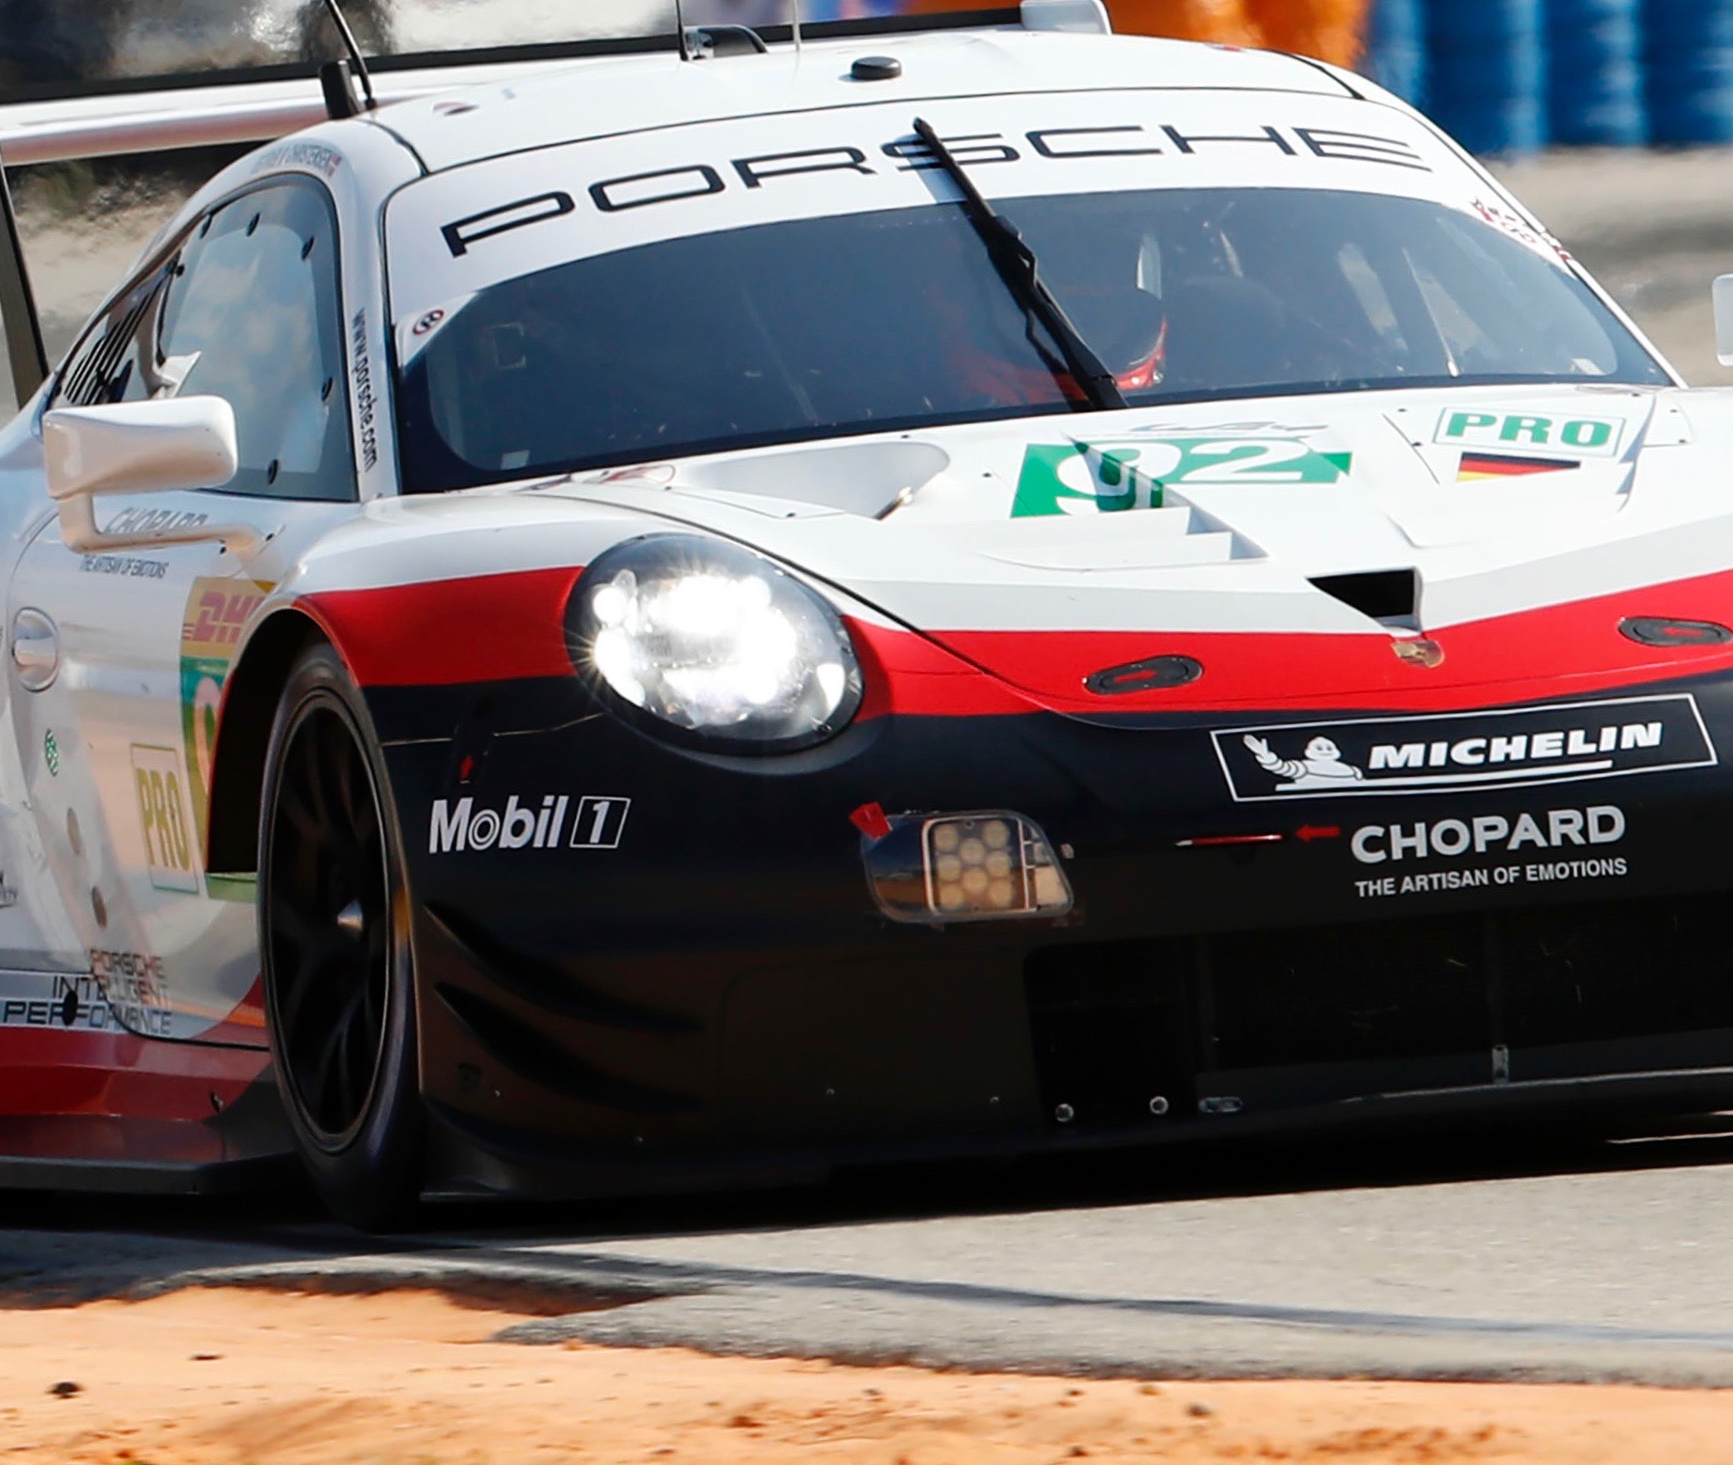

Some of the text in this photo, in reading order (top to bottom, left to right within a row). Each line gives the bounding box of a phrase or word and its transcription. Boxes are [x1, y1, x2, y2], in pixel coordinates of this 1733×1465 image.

[440, 124, 1433, 259] PORSCHE
[351, 307, 379, 473] www.porsche.com
[1445, 412, 1613, 448] PRO
[1055, 438, 1309, 515] 92
[194, 591, 264, 642] DH
[1368, 722, 1663, 770] MICHELIN
[136, 767, 191, 872] PRO
[429, 794, 611, 854] Mobil 1
[1350, 805, 1627, 864] CHOPARD
[1354, 857, 1628, 897] THE ARTISAN OF EMOTIONS
